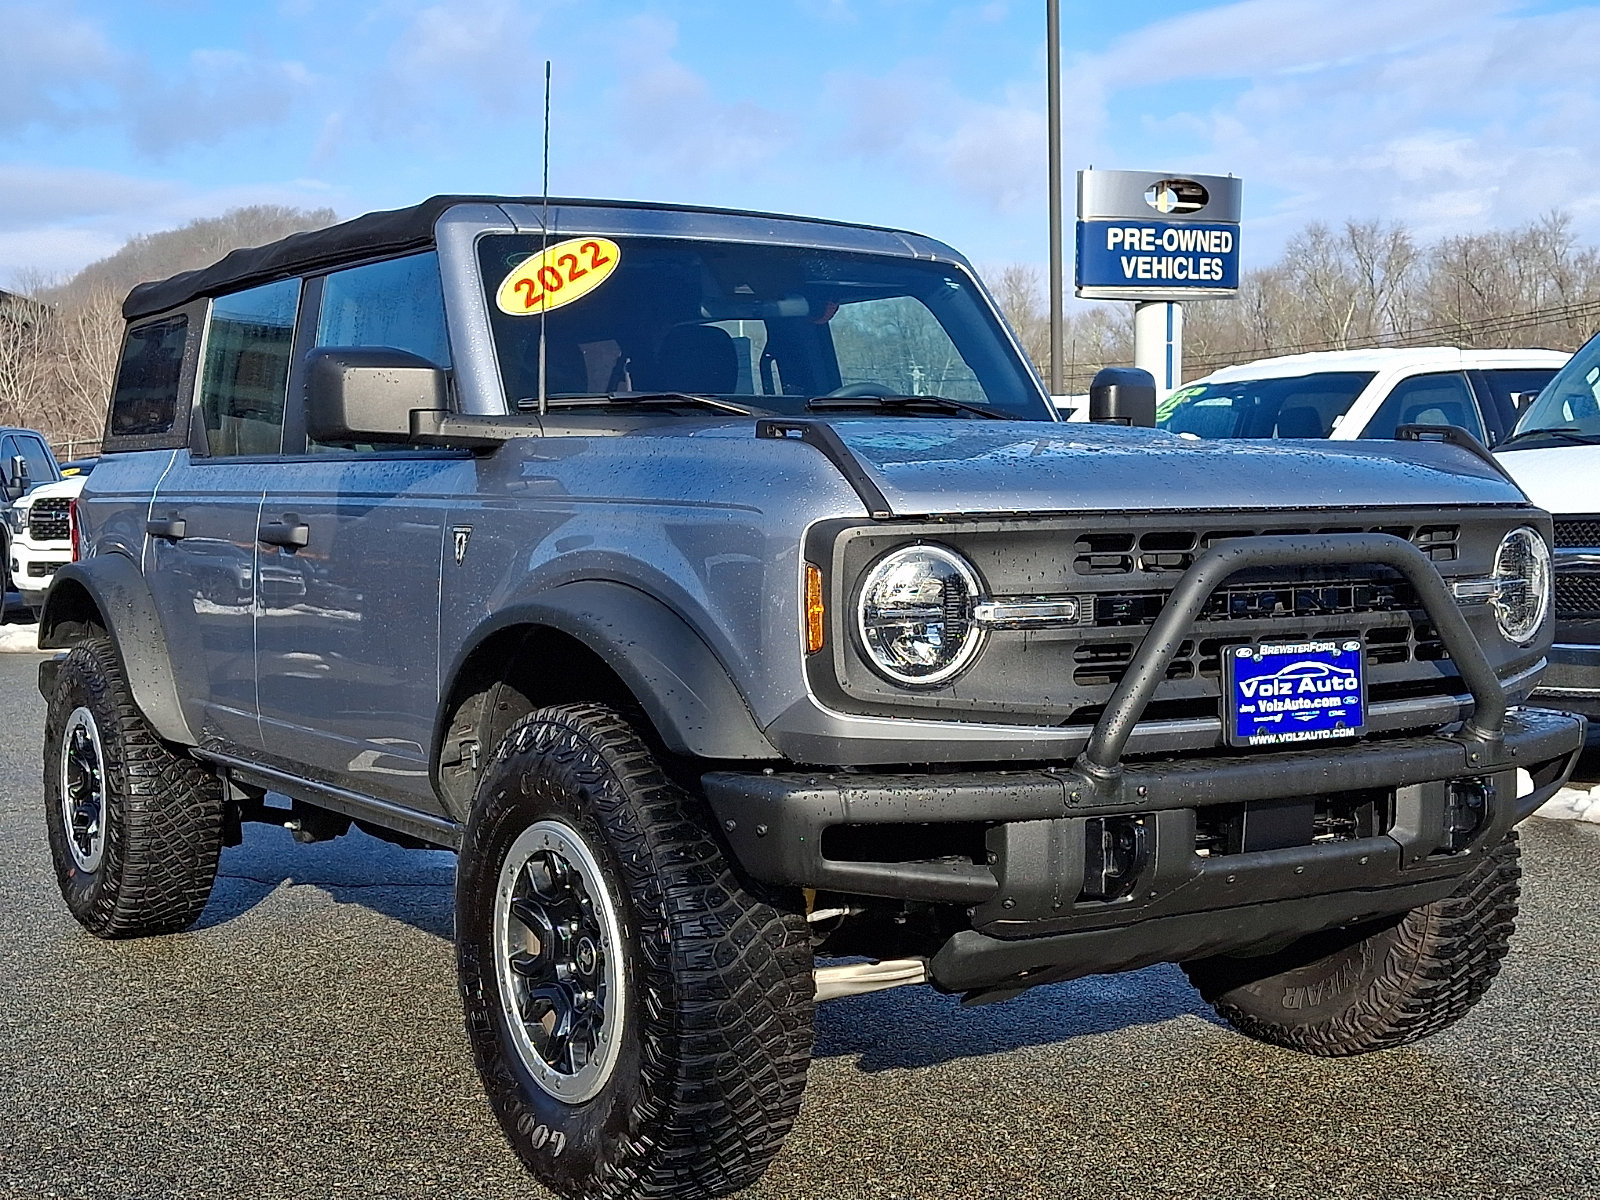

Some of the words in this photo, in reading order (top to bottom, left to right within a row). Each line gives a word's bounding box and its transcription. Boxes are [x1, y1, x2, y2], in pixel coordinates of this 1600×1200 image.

[1107, 227, 1233, 253] PRE-OWNED
[514, 241, 610, 308] 2022
[1120, 256, 1223, 281] VEHICLES
[1239, 678, 1293, 698] Volz
[1297, 675, 1358, 694] Auto
[1258, 696, 1342, 712] VolzAuto.com
[1249, 727, 1355, 746] WWW.VOLZAUTO.COM
